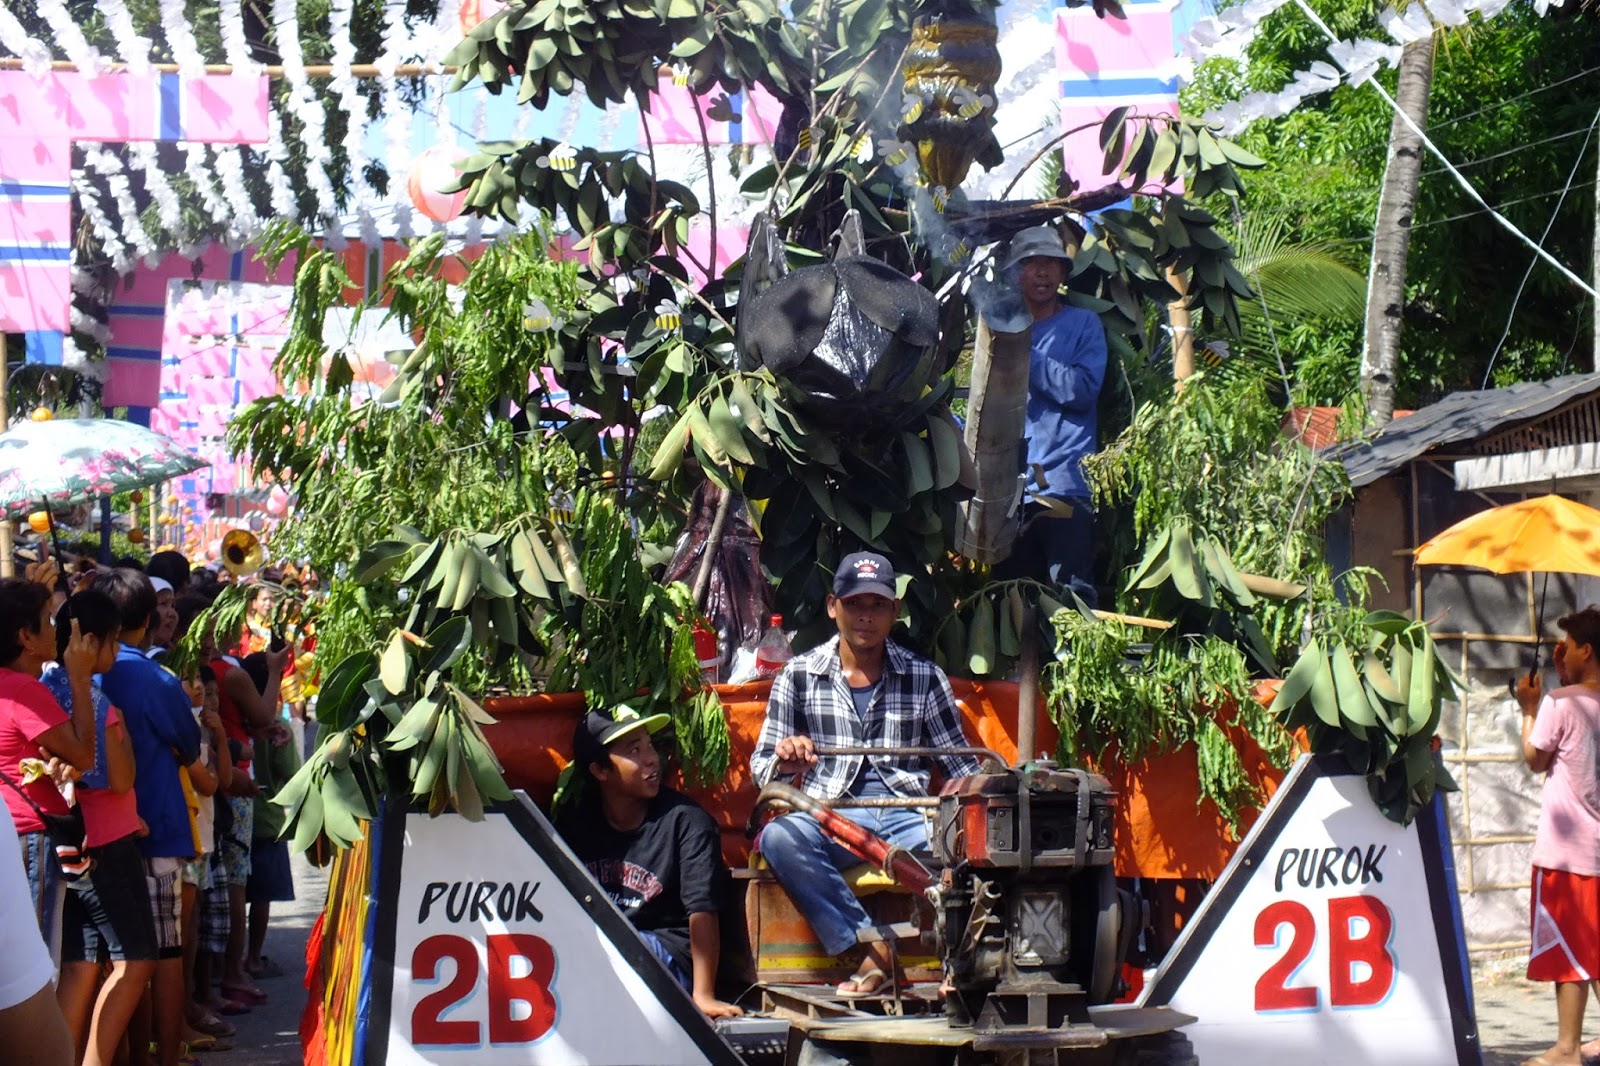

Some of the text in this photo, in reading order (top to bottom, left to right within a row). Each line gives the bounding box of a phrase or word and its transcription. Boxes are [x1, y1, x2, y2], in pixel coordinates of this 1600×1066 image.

[418, 881, 543, 924] PUROK
[1275, 844, 1387, 892] PUROK
[412, 934, 562, 1051] 2B
[1254, 895, 1400, 1015] 2B
